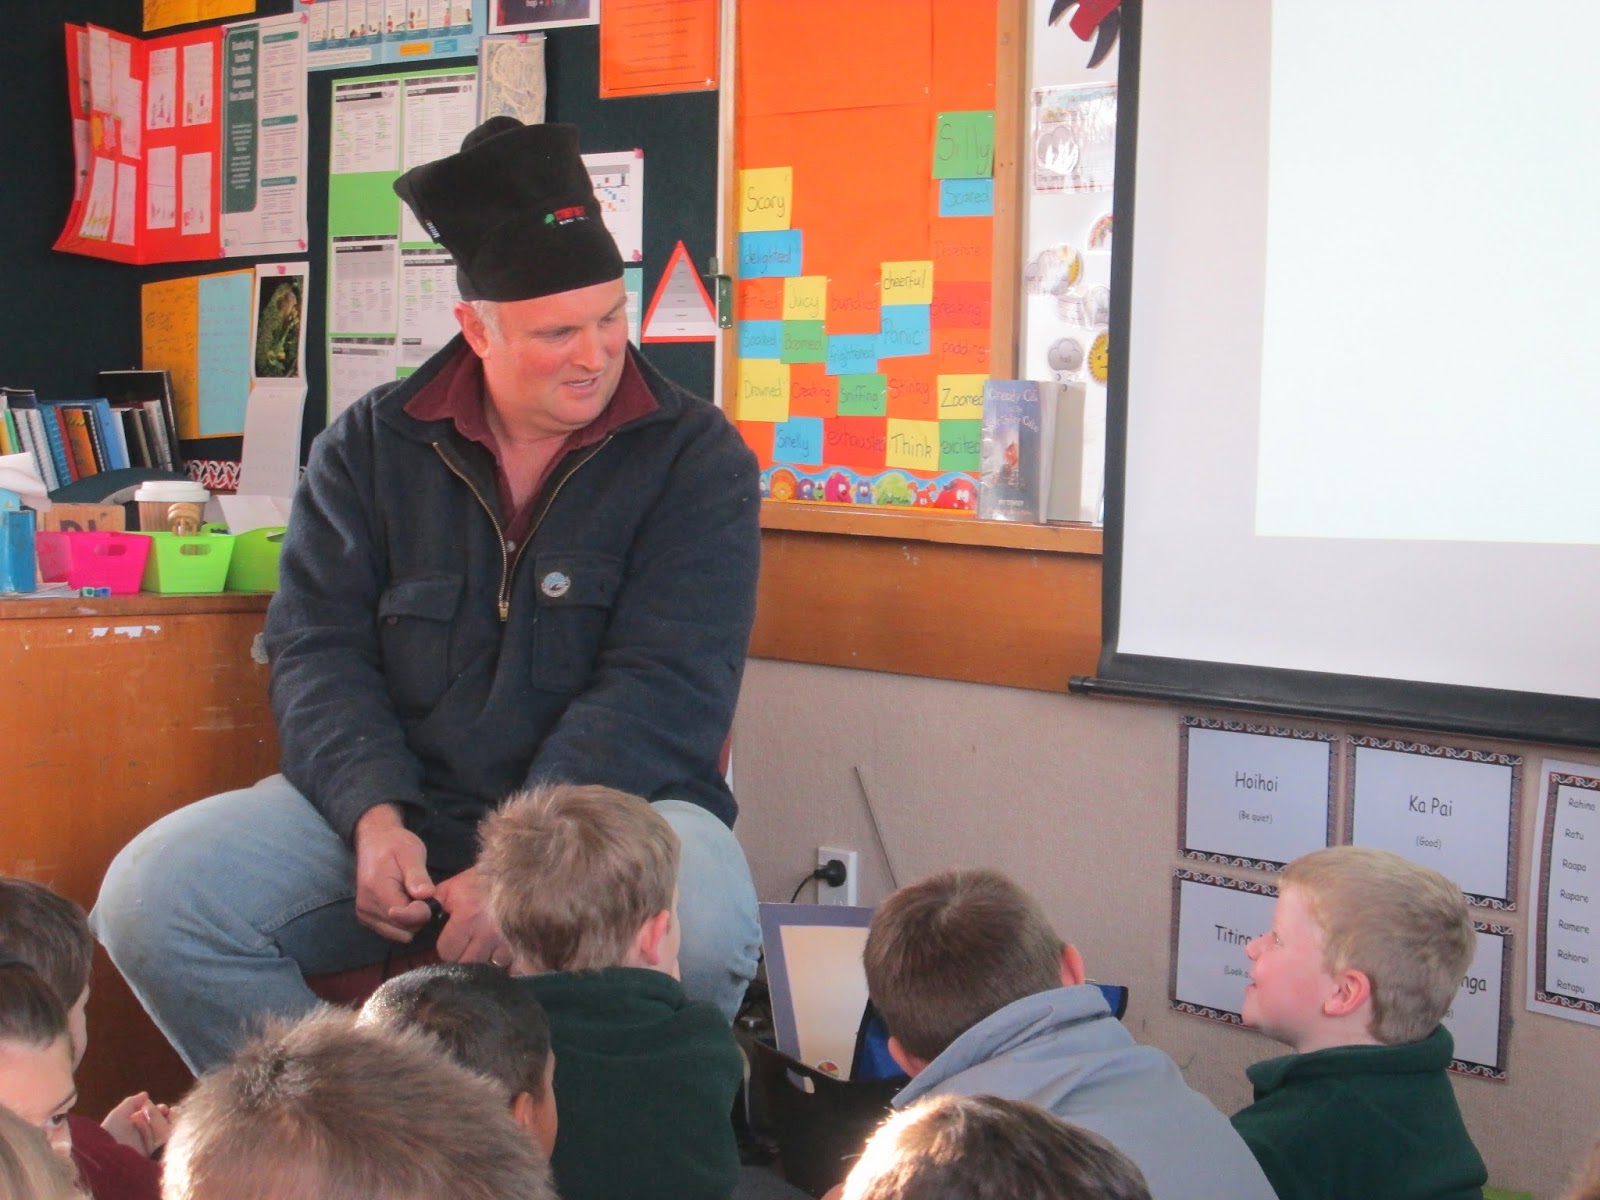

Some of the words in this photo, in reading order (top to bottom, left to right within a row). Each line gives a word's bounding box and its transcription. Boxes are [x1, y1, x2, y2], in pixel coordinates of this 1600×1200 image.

[937, 123, 991, 176] Silly
[746, 186, 785, 217] Scary
[744, 238, 792, 274] delighted
[883, 269, 926, 290] cheerful
[787, 289, 819, 318] Juicy
[881, 317, 923, 346] Panic
[744, 379, 784, 399] Drowned
[941, 385, 985, 408] Zoomed
[890, 433, 933, 459] Think
[1235, 770, 1279, 792] Hoihoi
[1409, 794, 1426, 813] Ka
[1431, 797, 1453, 817] Pai
[1416, 835, 1442, 850] (Good)
[1564, 828, 1585, 841] Ratu
[1562, 858, 1588, 873] Raapa
[1560, 889, 1590, 904] Rapare
[1558, 919, 1590, 935] Ramere
[1461, 975, 1487, 995] nga
[1556, 979, 1586, 995] Ratapu
